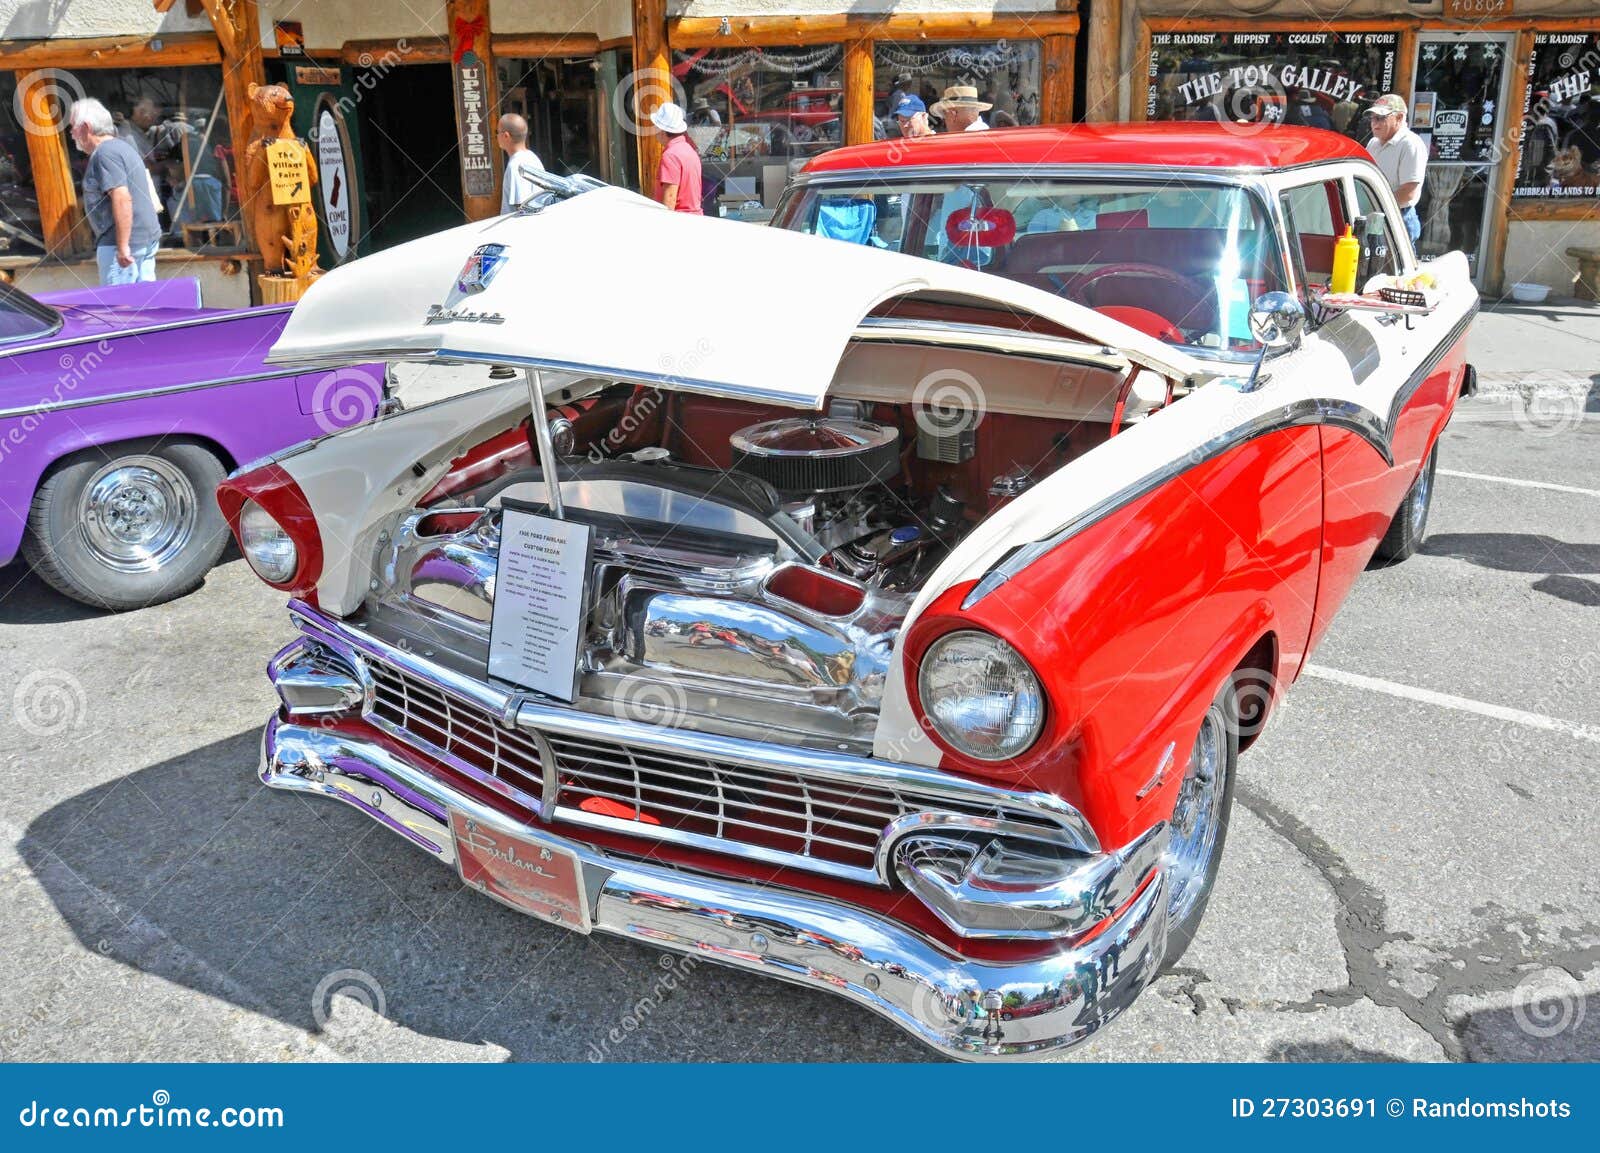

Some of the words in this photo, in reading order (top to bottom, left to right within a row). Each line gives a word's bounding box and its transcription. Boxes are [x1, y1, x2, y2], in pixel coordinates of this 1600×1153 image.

[1152, 34, 1171, 44] THE
[1174, 34, 1215, 44] RADDIST
[1233, 34, 1270, 44] HIPPIST
[1288, 34, 1327, 44] COOLIST
[1345, 34, 1363, 44] TOY
[1365, 34, 1395, 44] STORE
[1535, 34, 1547, 44] HE
[1550, 34, 1588, 44] RADDIST
[1149, 50, 1159, 77] GIFTS
[1381, 51, 1394, 93] POSTERS
[1177, 71, 1223, 105] THE
[1229, 63, 1273, 90] TOY
[1280, 64, 1363, 103] GALLEY
[1550, 70, 1592, 102] THE
[462, 68, 485, 155] UPSTAIRS
[1146, 85, 1157, 116] GAMES
[1437, 113, 1465, 124] CLOSED
[1552, 186, 1582, 196] ISLANDS
[1584, 186, 1594, 196] TO
[456, 832, 557, 879] Fairlane
